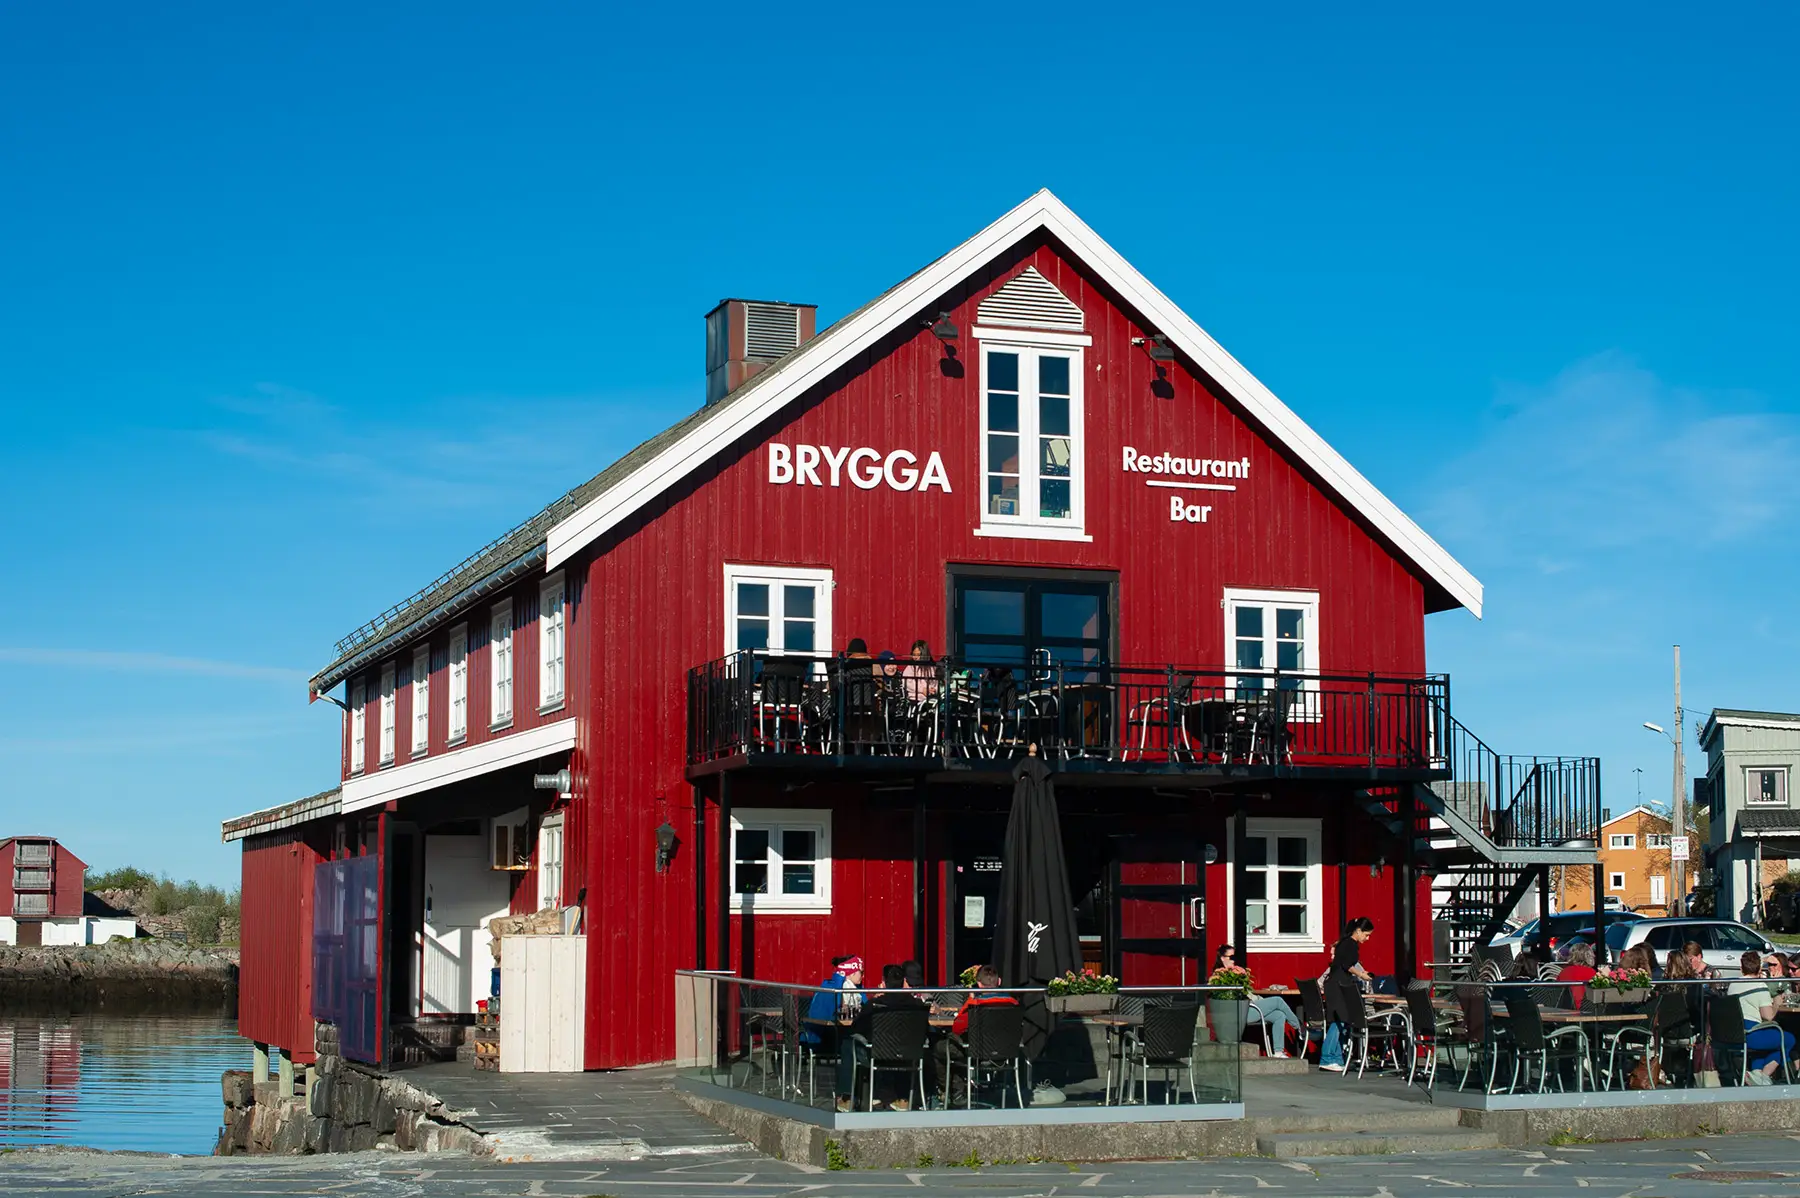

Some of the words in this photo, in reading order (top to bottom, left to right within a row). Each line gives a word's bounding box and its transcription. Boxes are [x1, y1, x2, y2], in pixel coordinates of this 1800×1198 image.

[768, 442, 953, 493] BRYGGA
[1122, 446, 1251, 479] Restaurant
[1170, 495, 1213, 523] Bar
